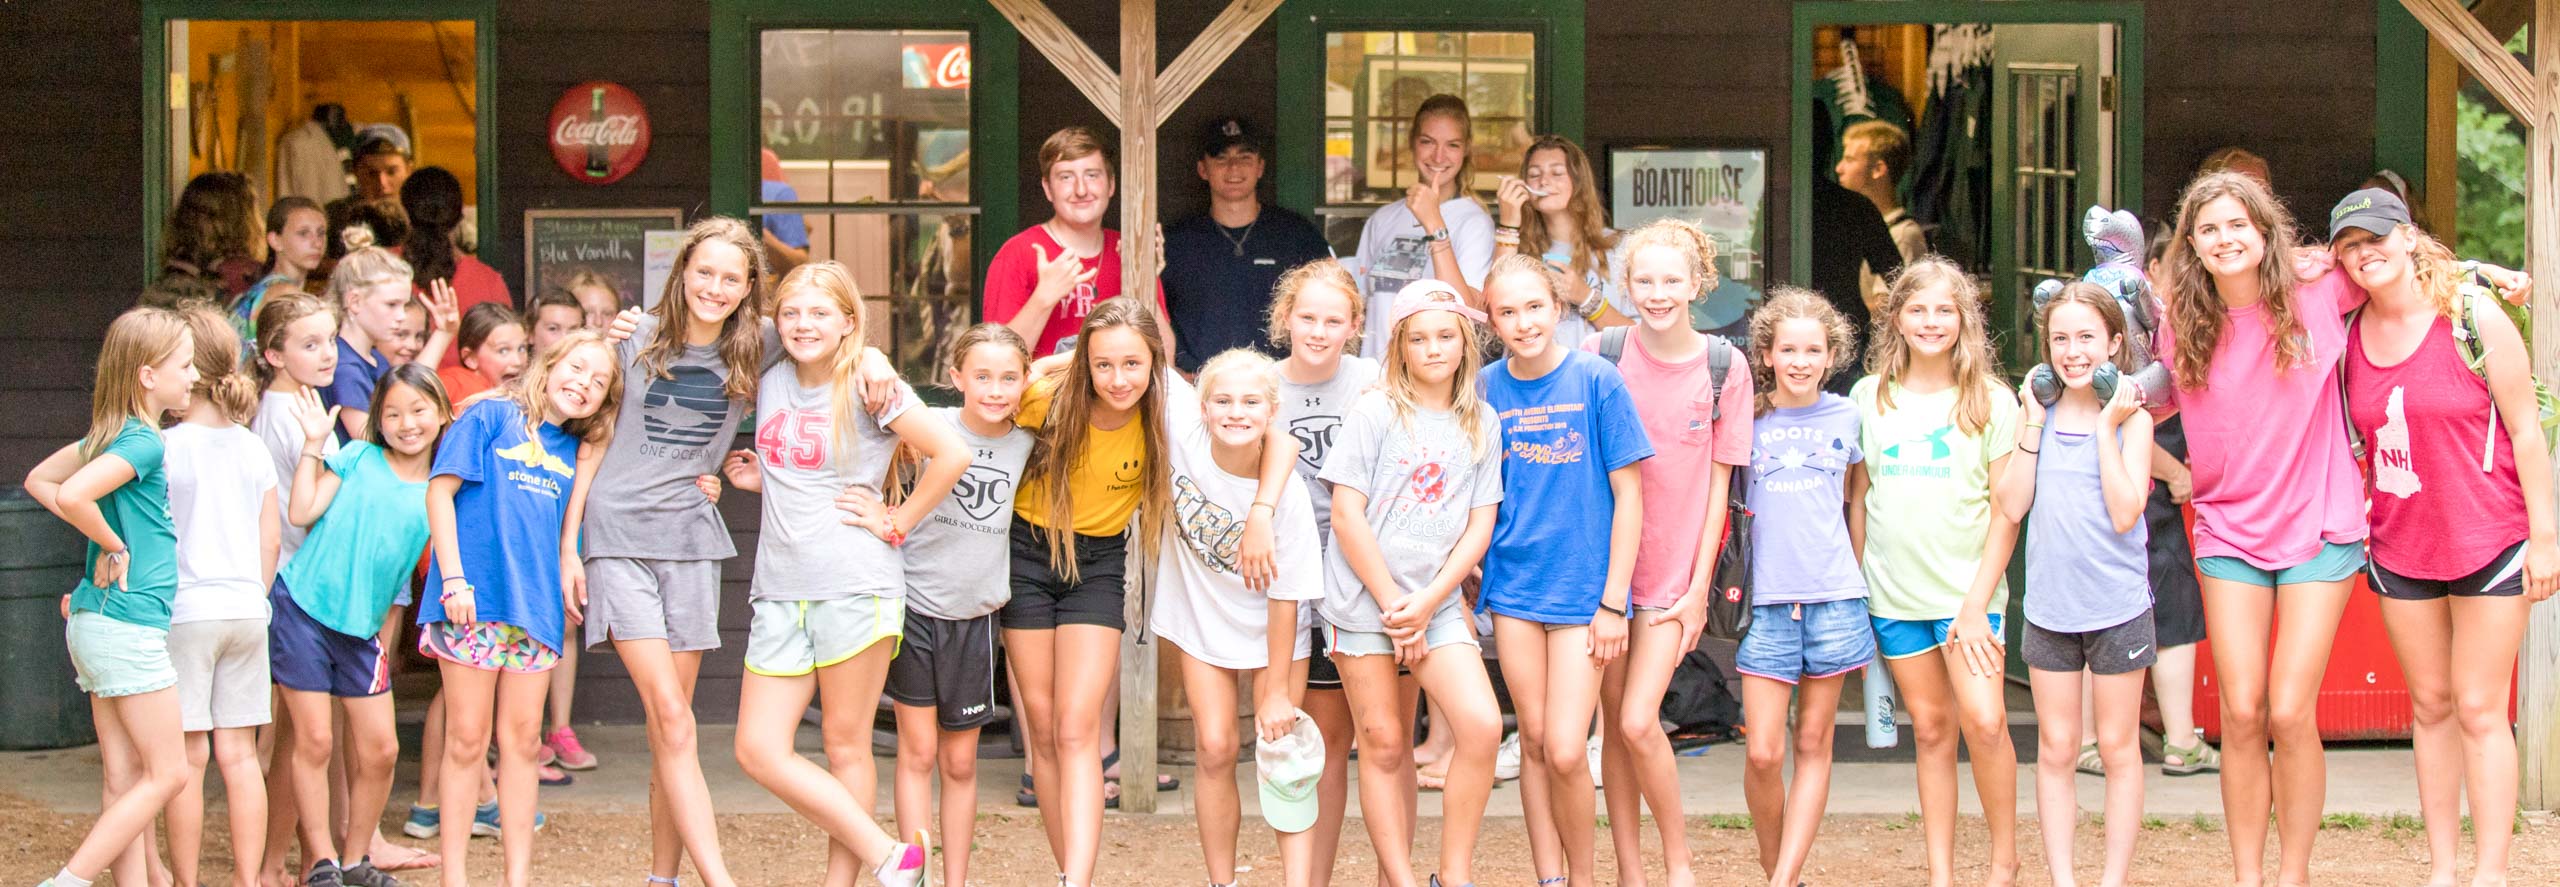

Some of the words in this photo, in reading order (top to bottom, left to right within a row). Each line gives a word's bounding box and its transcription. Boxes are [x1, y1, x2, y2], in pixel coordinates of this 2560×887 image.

[1633, 164, 1745, 208] BOATHOUSE
[575, 239, 634, 262] Vanilla
[757, 408, 831, 470] 45
[1760, 426, 1824, 446] ROOTS
[639, 443, 665, 457] ONE
[671, 448, 711, 461] OCEAN
[2380, 448, 2409, 471] NH
[508, 470, 541, 486] stone
[1765, 476, 1824, 492] CANADA
[951, 472, 1011, 510] SJC
[934, 514, 959, 527] GIRLS
[959, 520, 993, 535] SOCCER
[1386, 508, 1457, 538] SOCCER
